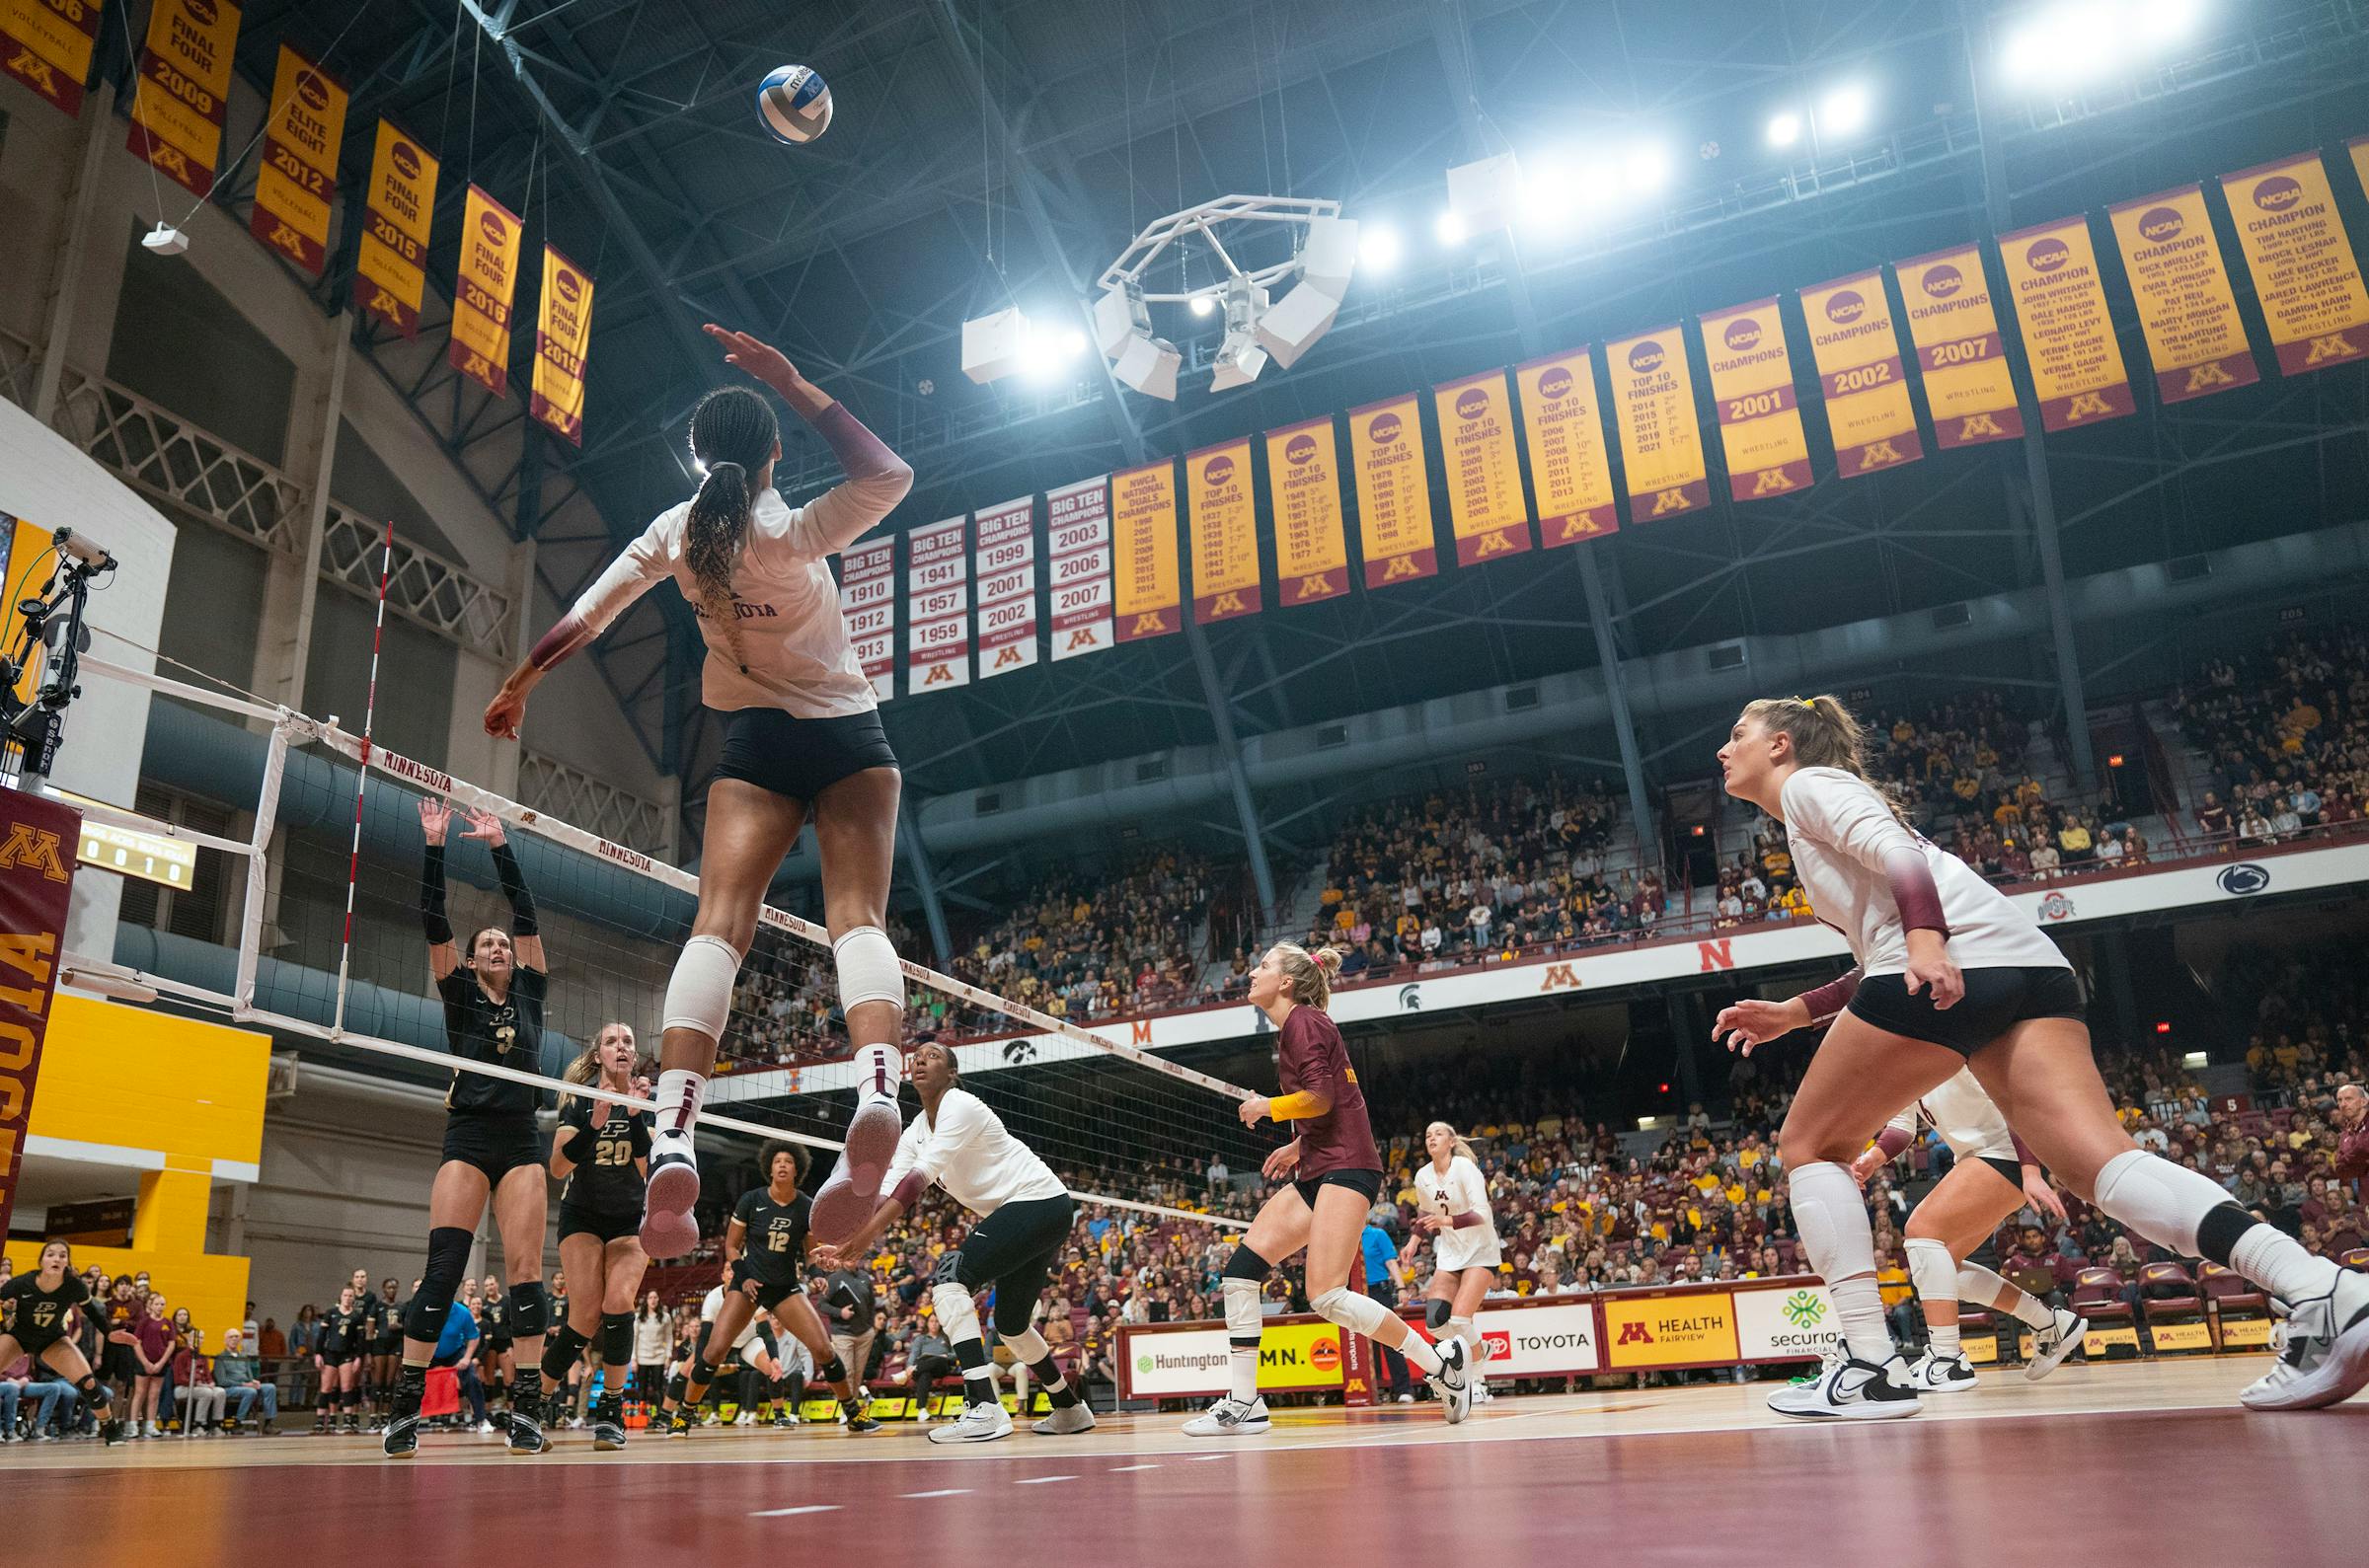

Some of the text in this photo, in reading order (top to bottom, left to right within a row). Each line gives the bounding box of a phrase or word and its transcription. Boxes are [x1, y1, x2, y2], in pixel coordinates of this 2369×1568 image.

[172, 15, 217, 58] FINAL
[170, 35, 213, 75] FOUR
[155, 61, 213, 114] 2009
[290, 104, 327, 138] ELITE
[285, 119, 327, 155] EIGHT
[275, 147, 324, 193] 2012
[393, 151, 420, 178] NCAA
[386, 174, 420, 208] FINAL
[2259, 187, 2302, 207] NCAA
[385, 190, 418, 223] FOUR
[2145, 219, 2184, 238] NCAA
[2248, 203, 2326, 233] CHAMPION
[374, 217, 418, 261] 2015
[482, 220, 506, 244] NCAA
[475, 242, 507, 274] FINAL
[2133, 235, 2206, 262] CHAMPION
[2032, 252, 2070, 267] NCAA
[475, 259, 504, 288] FOUR
[1927, 275, 1963, 293] NCAA
[2021, 266, 2090, 292] CHAMPION
[466, 284, 506, 325] 2016
[552, 299, 580, 329] FINAL
[1830, 302, 1865, 320] NCAA
[1911, 294, 1988, 321] CHAMPIONS
[552, 314, 578, 340] FOUR
[1815, 318, 1889, 346] CHAMPIONS
[2291, 315, 2353, 336] WRESTLING
[1728, 330, 1762, 346] NCAA
[543, 338, 578, 375] 2019
[1632, 351, 1666, 368] NCAA
[1713, 347, 1785, 373] CHAMPIONS
[1931, 338, 1988, 366] 2007
[2173, 344, 2229, 364] WRESTLING
[1542, 378, 1574, 395] NCAA
[1632, 371, 1671, 388] TOP 10
[1834, 363, 1891, 394] 2002
[2055, 374, 2108, 393] WRESTLING
[1628, 380, 1679, 400] FINISHES
[1946, 385, 1997, 402] WRESTLING
[1459, 400, 1490, 414] NCAA
[1537, 405, 1587, 426] FINISHES
[1541, 397, 1580, 414] TOP 10
[1632, 401, 1656, 412] 2014
[1730, 391, 1783, 419] 2001
[1458, 418, 1495, 435] TOP 10
[1634, 411, 1657, 423] 2015
[1635, 420, 1659, 433] 2017
[1848, 410, 1896, 428] WRESTLING
[1372, 424, 1403, 438] NCAA
[1454, 426, 1501, 447] FINISHES
[1289, 445, 1318, 459] NCAA
[1370, 442, 1407, 460] TOP 10
[1742, 437, 1789, 455] WRESTLING
[1366, 451, 1414, 471] FINISHES
[1129, 475, 1157, 488] NWCA
[1207, 467, 1235, 481] NCAA
[1283, 472, 1327, 490] FINISHES
[1287, 464, 1321, 480] TOP 10
[1643, 471, 1691, 487] WRESTLING
[1122, 482, 1166, 500] NATIONAL
[1128, 493, 1159, 508] DUALS
[1200, 492, 1244, 511] FINISHES
[1204, 484, 1238, 500] TOP 10
[1051, 489, 1104, 515] BIG TEN
[1117, 499, 1171, 520] CHAMPIONS
[1554, 495, 1599, 511] WRESTLING
[979, 510, 1030, 536] BIG TEN
[1051, 503, 1106, 527] CHAMPIONS
[913, 529, 961, 555] BIG TEN
[979, 523, 1031, 547] CHAMPIONS
[1058, 524, 1099, 548] 2003
[844, 550, 890, 573] BIG TEN
[912, 543, 963, 565] CHAMPIONS
[987, 545, 1025, 567] 1999
[843, 562, 891, 584] CHAMPIONS
[920, 563, 955, 584] 1941
[1060, 557, 1100, 578] 2006
[850, 581, 885, 604] 1910
[987, 574, 1025, 597] 2001
[919, 593, 957, 614] 1957
[1060, 585, 1101, 609] 2007
[850, 610, 884, 633] 1912
[988, 604, 1027, 628] 2002
[1063, 610, 1100, 626] WRESTLING
[919, 623, 958, 644] 1959
[856, 639, 884, 660] 913
[384, 751, 452, 792] MINNESOTA
[599, 839, 651, 873] MINNESOTA
[765, 907, 806, 933] MINNESOTA
[1698, 938, 1734, 972] N
[899, 959, 931, 981] INNESOTA
[1540, 963, 1581, 991] M
[1003, 1001, 1031, 1020] MINNESOTA
[1131, 1019, 1152, 1046] M
[2227, 1098, 2238, 1111] 5
[599, 1119, 630, 1138] P
[595, 1140, 634, 1166] 20
[1434, 1190, 1449, 1201] M
[771, 1217, 792, 1231] P
[767, 1231, 790, 1252] 12
[35, 1302, 57, 1312] P
[33, 1313, 55, 1328] 17
[1658, 1316, 1723, 1333] HEALTH
[1517, 1333, 1589, 1351] TOYOTA
[1617, 1321, 1654, 1345] M
[1659, 1333, 1706, 1343] FAIRVIEW
[1771, 1332, 1841, 1348] securia
[1261, 1348, 1306, 1367] MN.
[1786, 1346, 1834, 1355] FINANCIAL
[1155, 1353, 1228, 1372] Huntington
